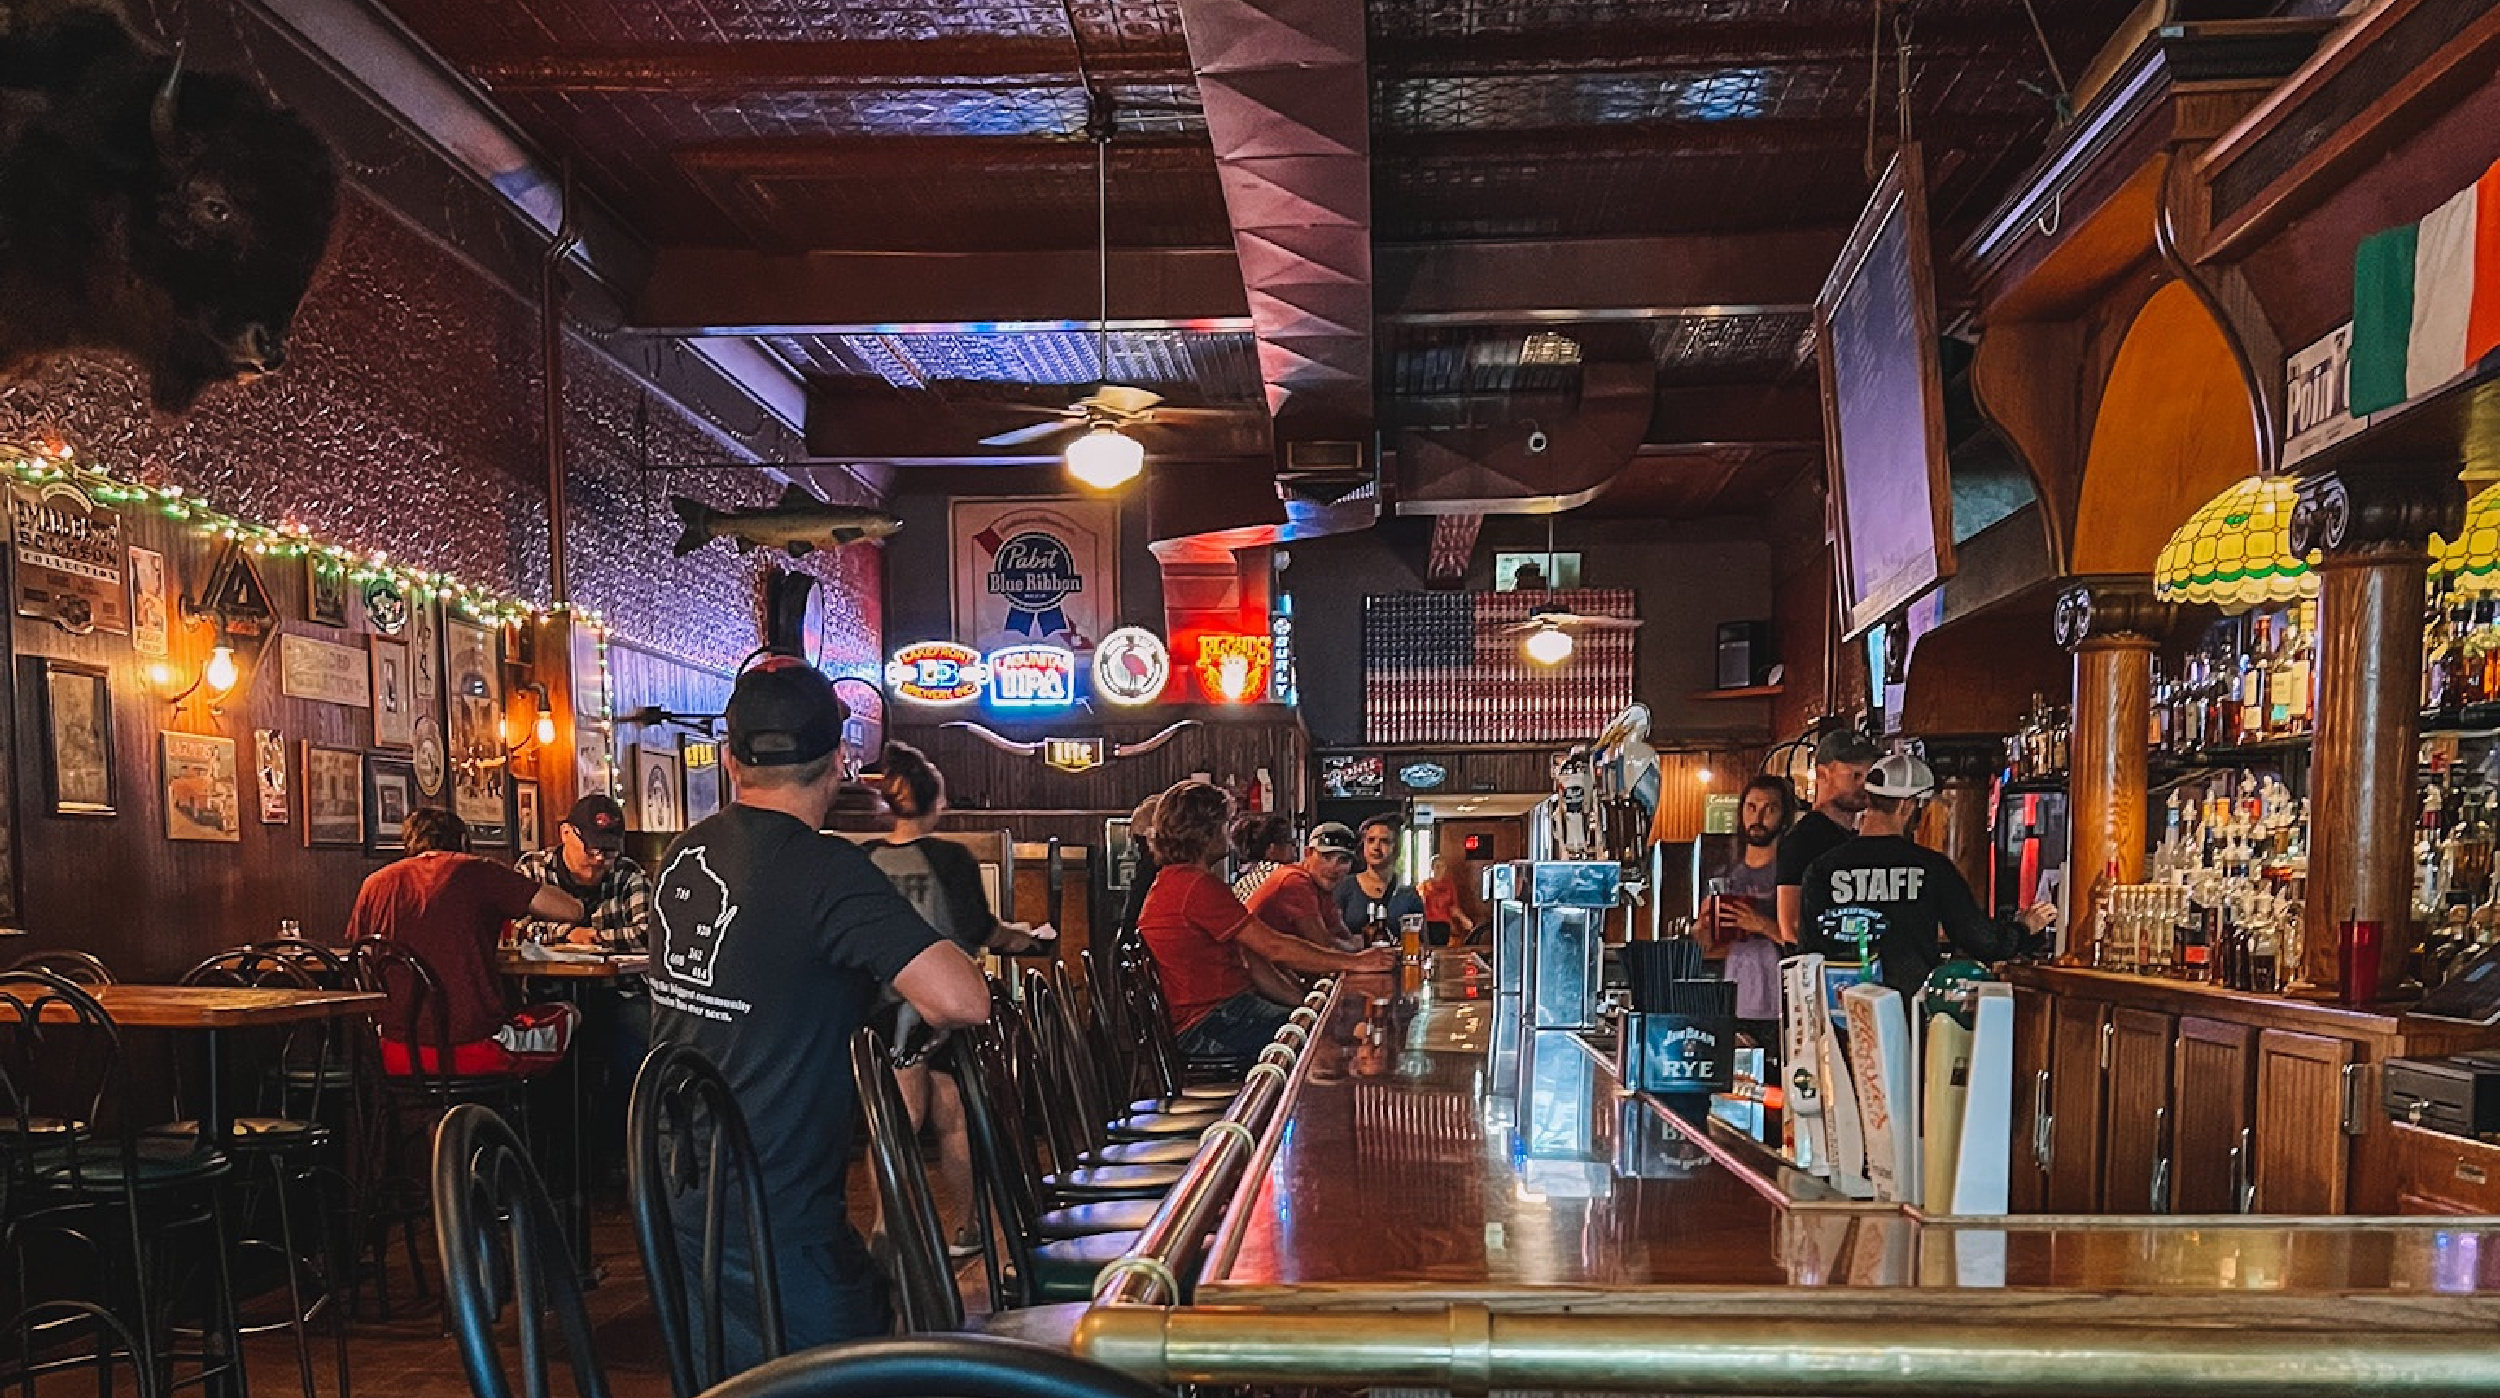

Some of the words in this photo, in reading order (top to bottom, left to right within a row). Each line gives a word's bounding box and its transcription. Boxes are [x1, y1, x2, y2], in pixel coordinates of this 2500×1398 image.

[1003, 543, 1059, 569] Pabst
[990, 573, 1024, 591] Blue
[1026, 573, 1081, 591] Ribbon
[1830, 867, 1925, 904] STAFF
[1661, 1060, 1715, 1078] RYE
